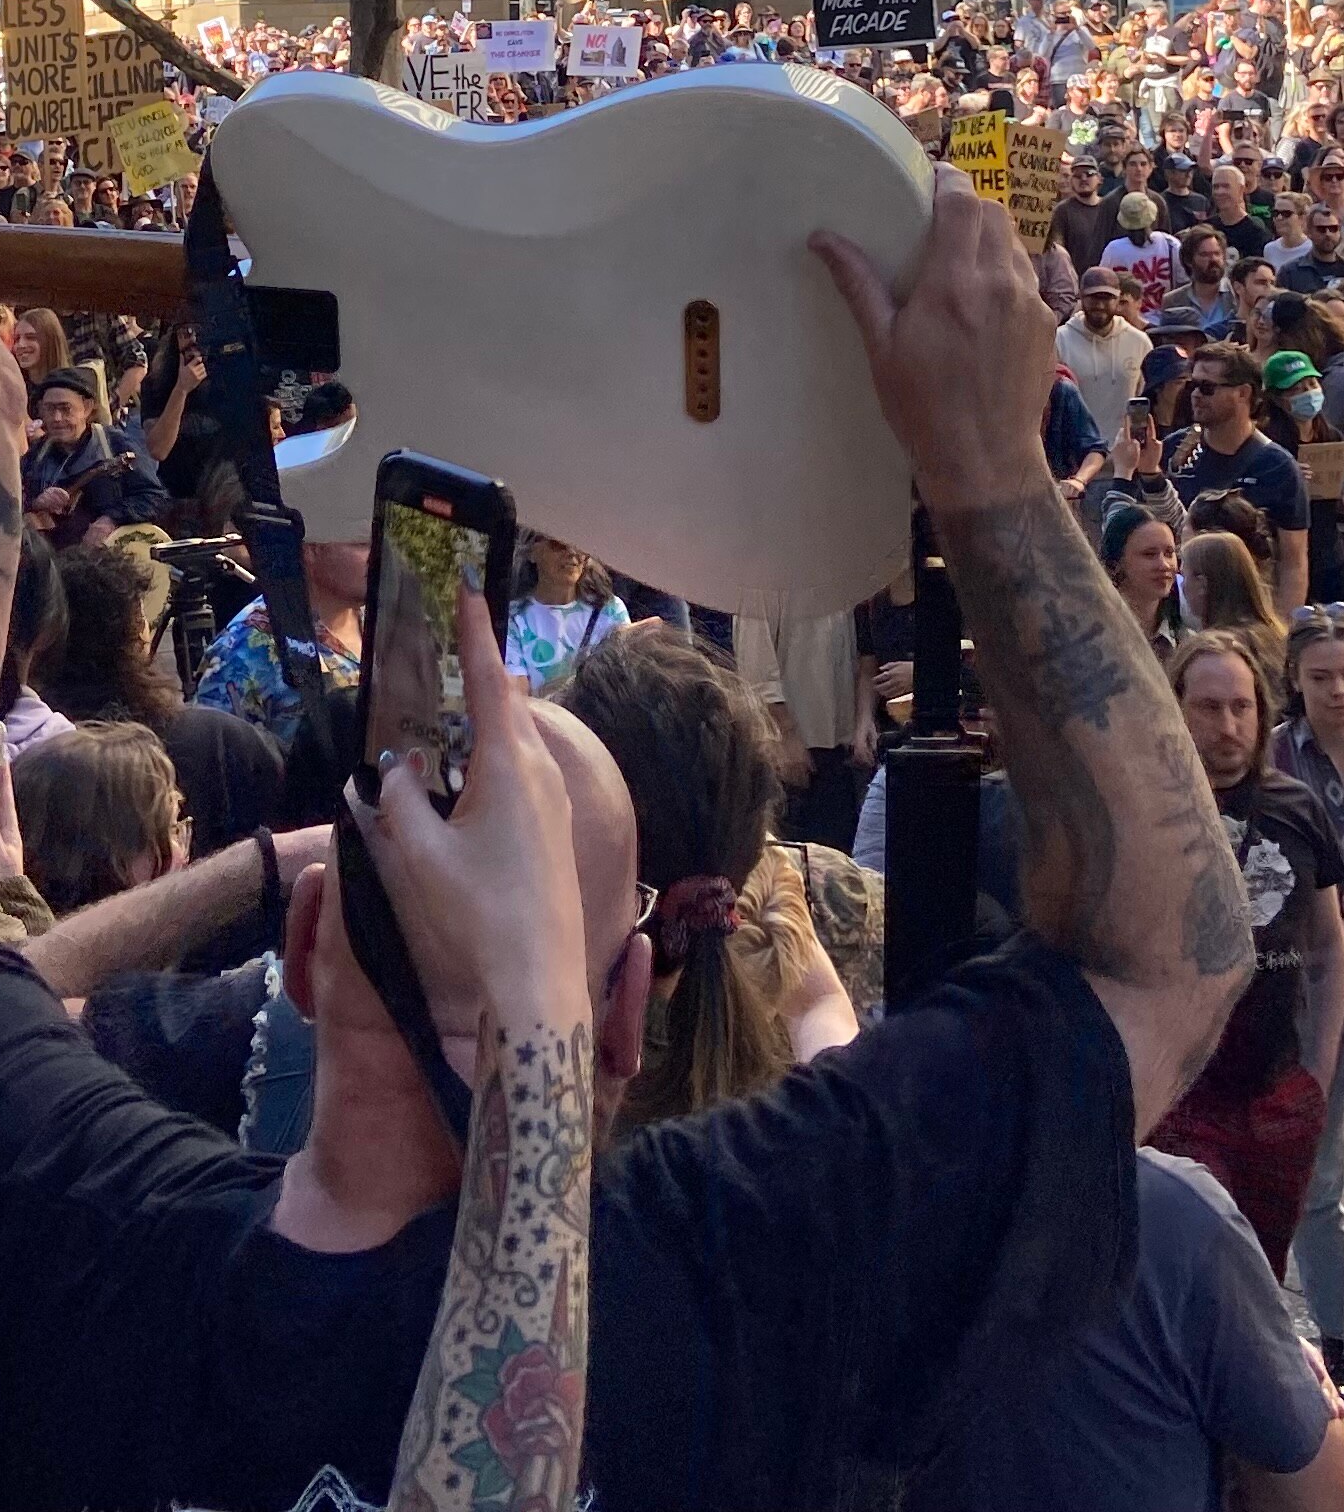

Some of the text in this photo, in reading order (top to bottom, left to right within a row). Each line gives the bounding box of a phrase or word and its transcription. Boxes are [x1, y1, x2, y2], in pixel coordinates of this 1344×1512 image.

[829, 9, 911, 38] FACADE
[585, 33, 609, 49] NO!
[8, 63, 77, 96] MORE
[452, 64, 484, 89] the
[6, 97, 91, 140] COWBELL
